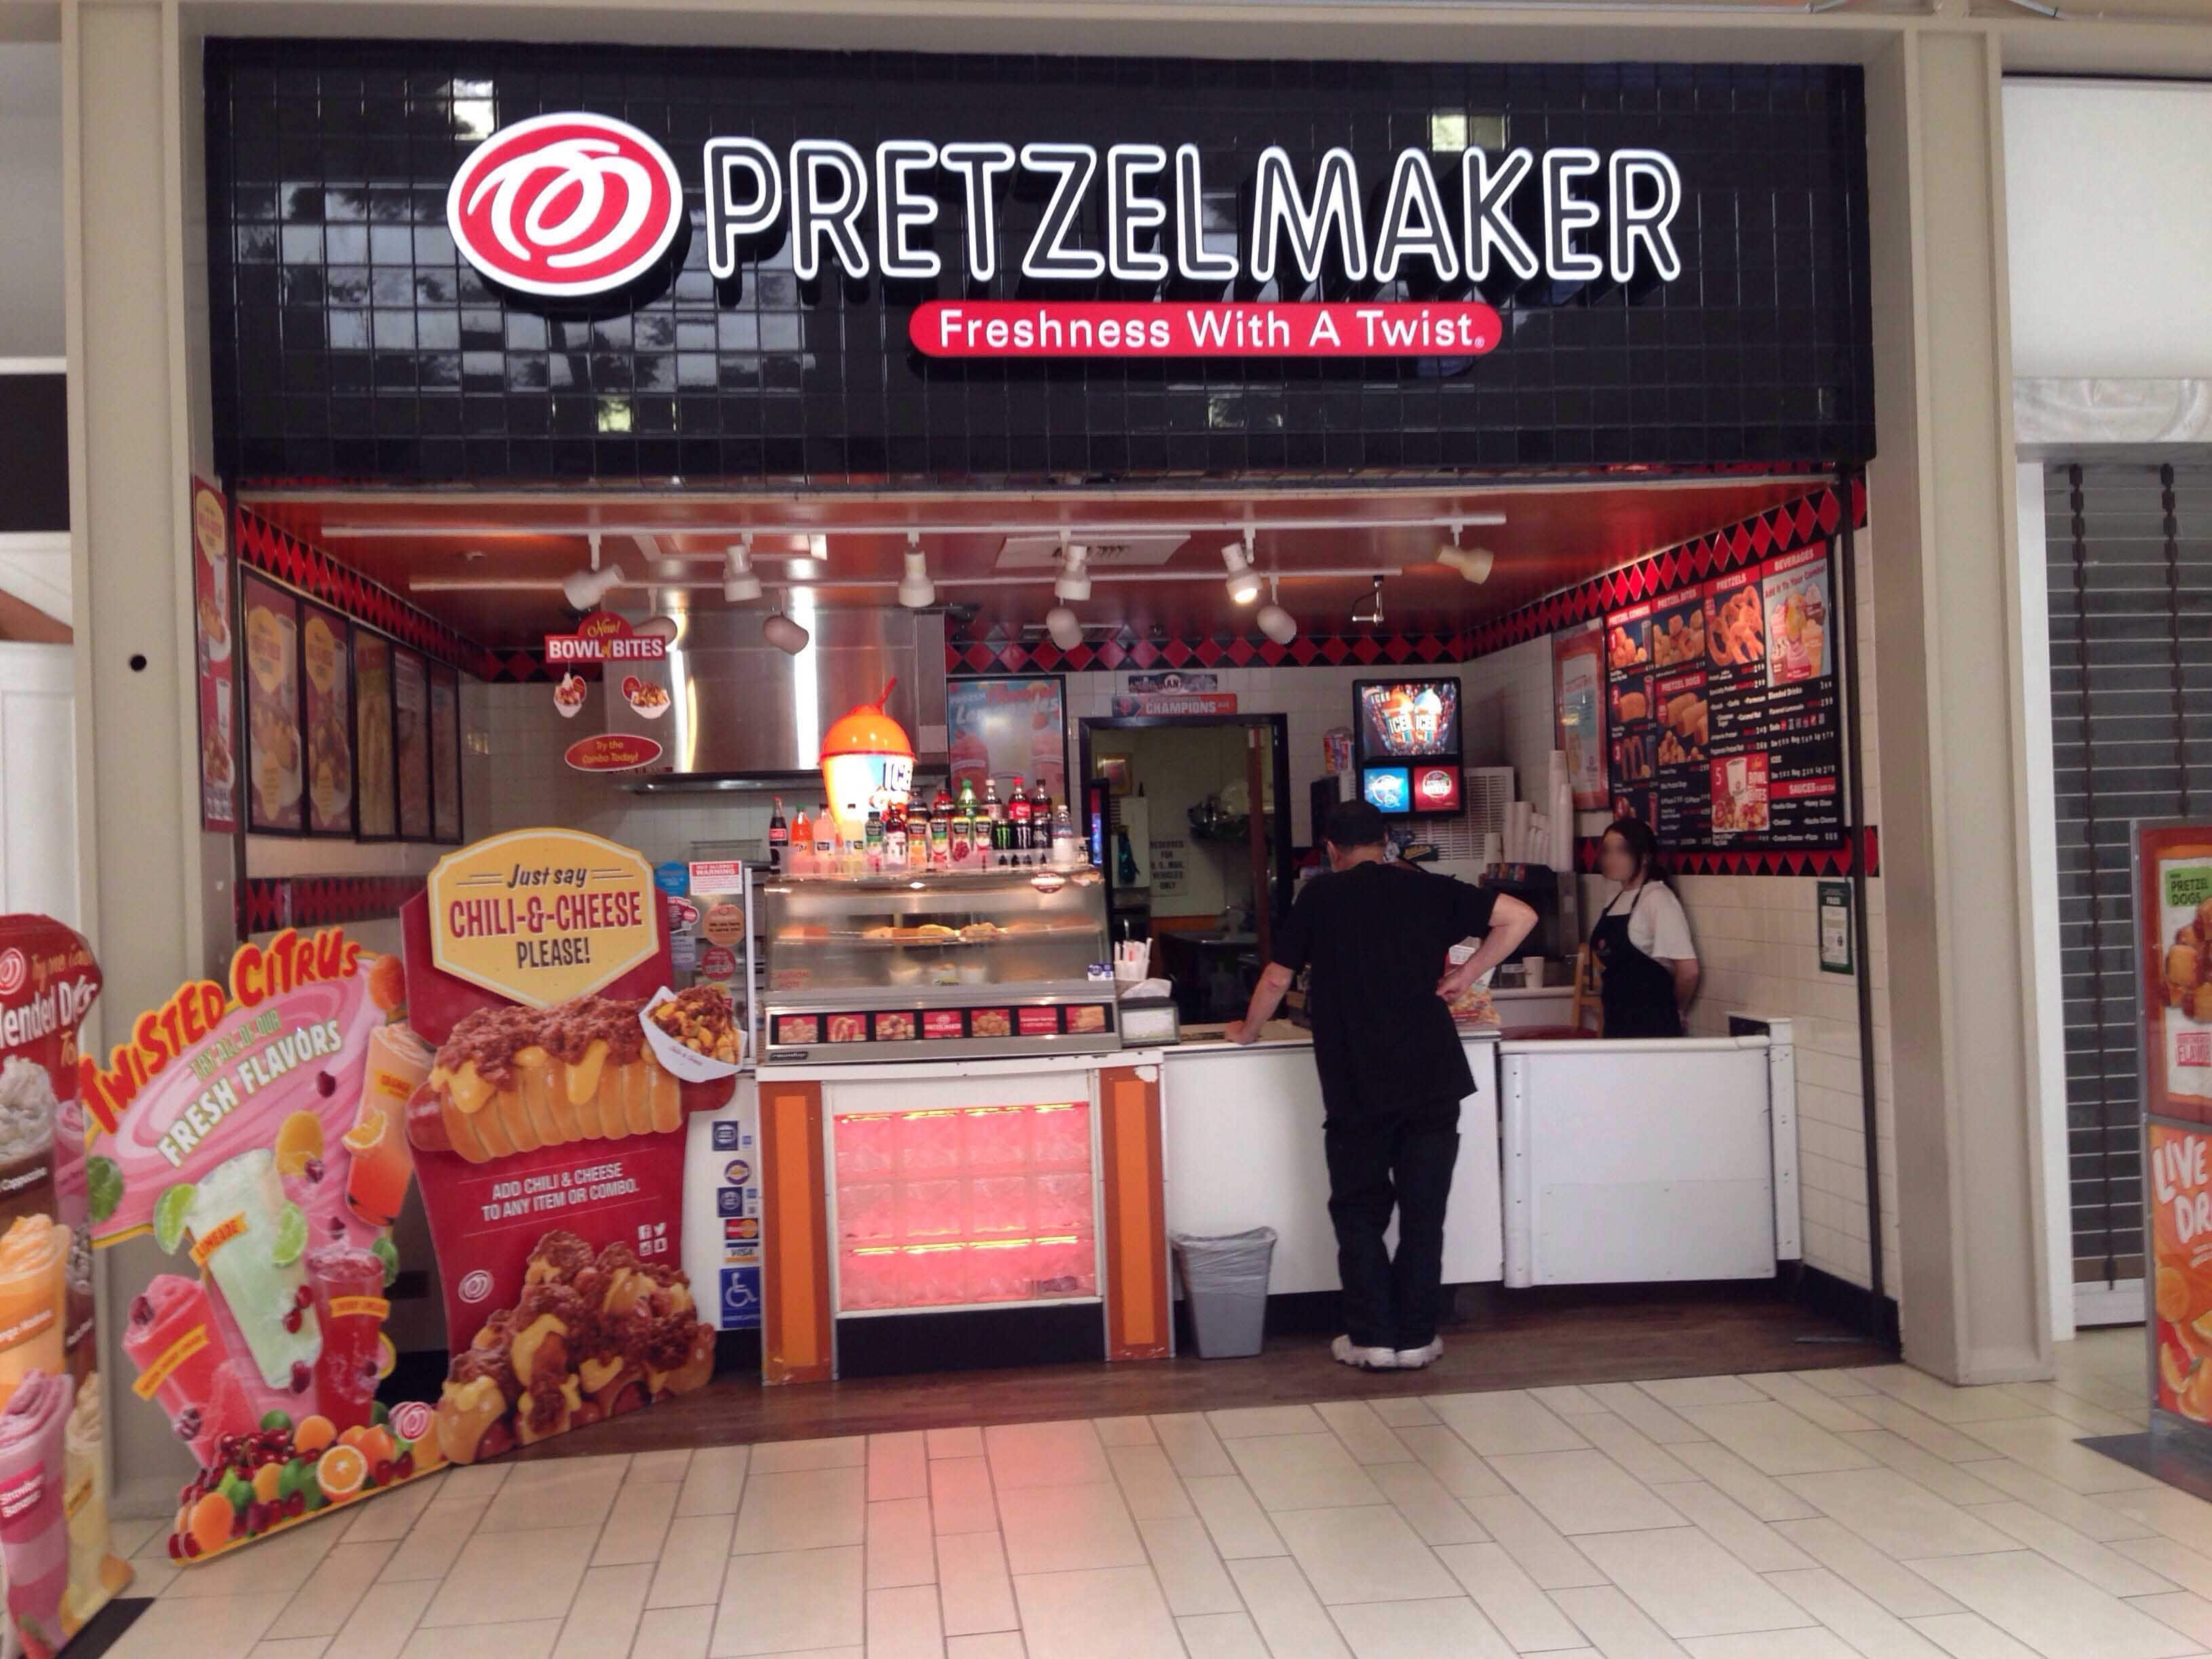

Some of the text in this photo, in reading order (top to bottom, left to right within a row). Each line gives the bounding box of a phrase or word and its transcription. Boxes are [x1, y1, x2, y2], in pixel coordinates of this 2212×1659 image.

[703, 136, 1681, 282] PRETZELMAKER
[939, 308, 1170, 348] Freshness
[1186, 309, 1290, 348] With
[1309, 309, 1341, 347] A
[548, 639, 604, 659] BOWL
[613, 638, 663, 658] BITES
[1146, 701, 1216, 714] CHAMPIONS
[507, 863, 588, 888] Just say
[232, 929, 362, 1008] CITRUS
[515, 937, 591, 969] PLEASE!
[0, 985, 58, 1049] lended
[80, 982, 226, 1134] TWISTED
[157, 1019, 342, 1168] FRESH FLAVORS
[492, 1162, 623, 1201] ADD CHILI & CHEESE
[2152, 1133, 2208, 1206] LIVE
[481, 1204, 501, 1222] TO
[502, 1197, 531, 1218] ANY
[533, 1191, 567, 1212] ITEM
[568, 1187, 587, 1205] OR
[2174, 1191, 2212, 1245] DR
